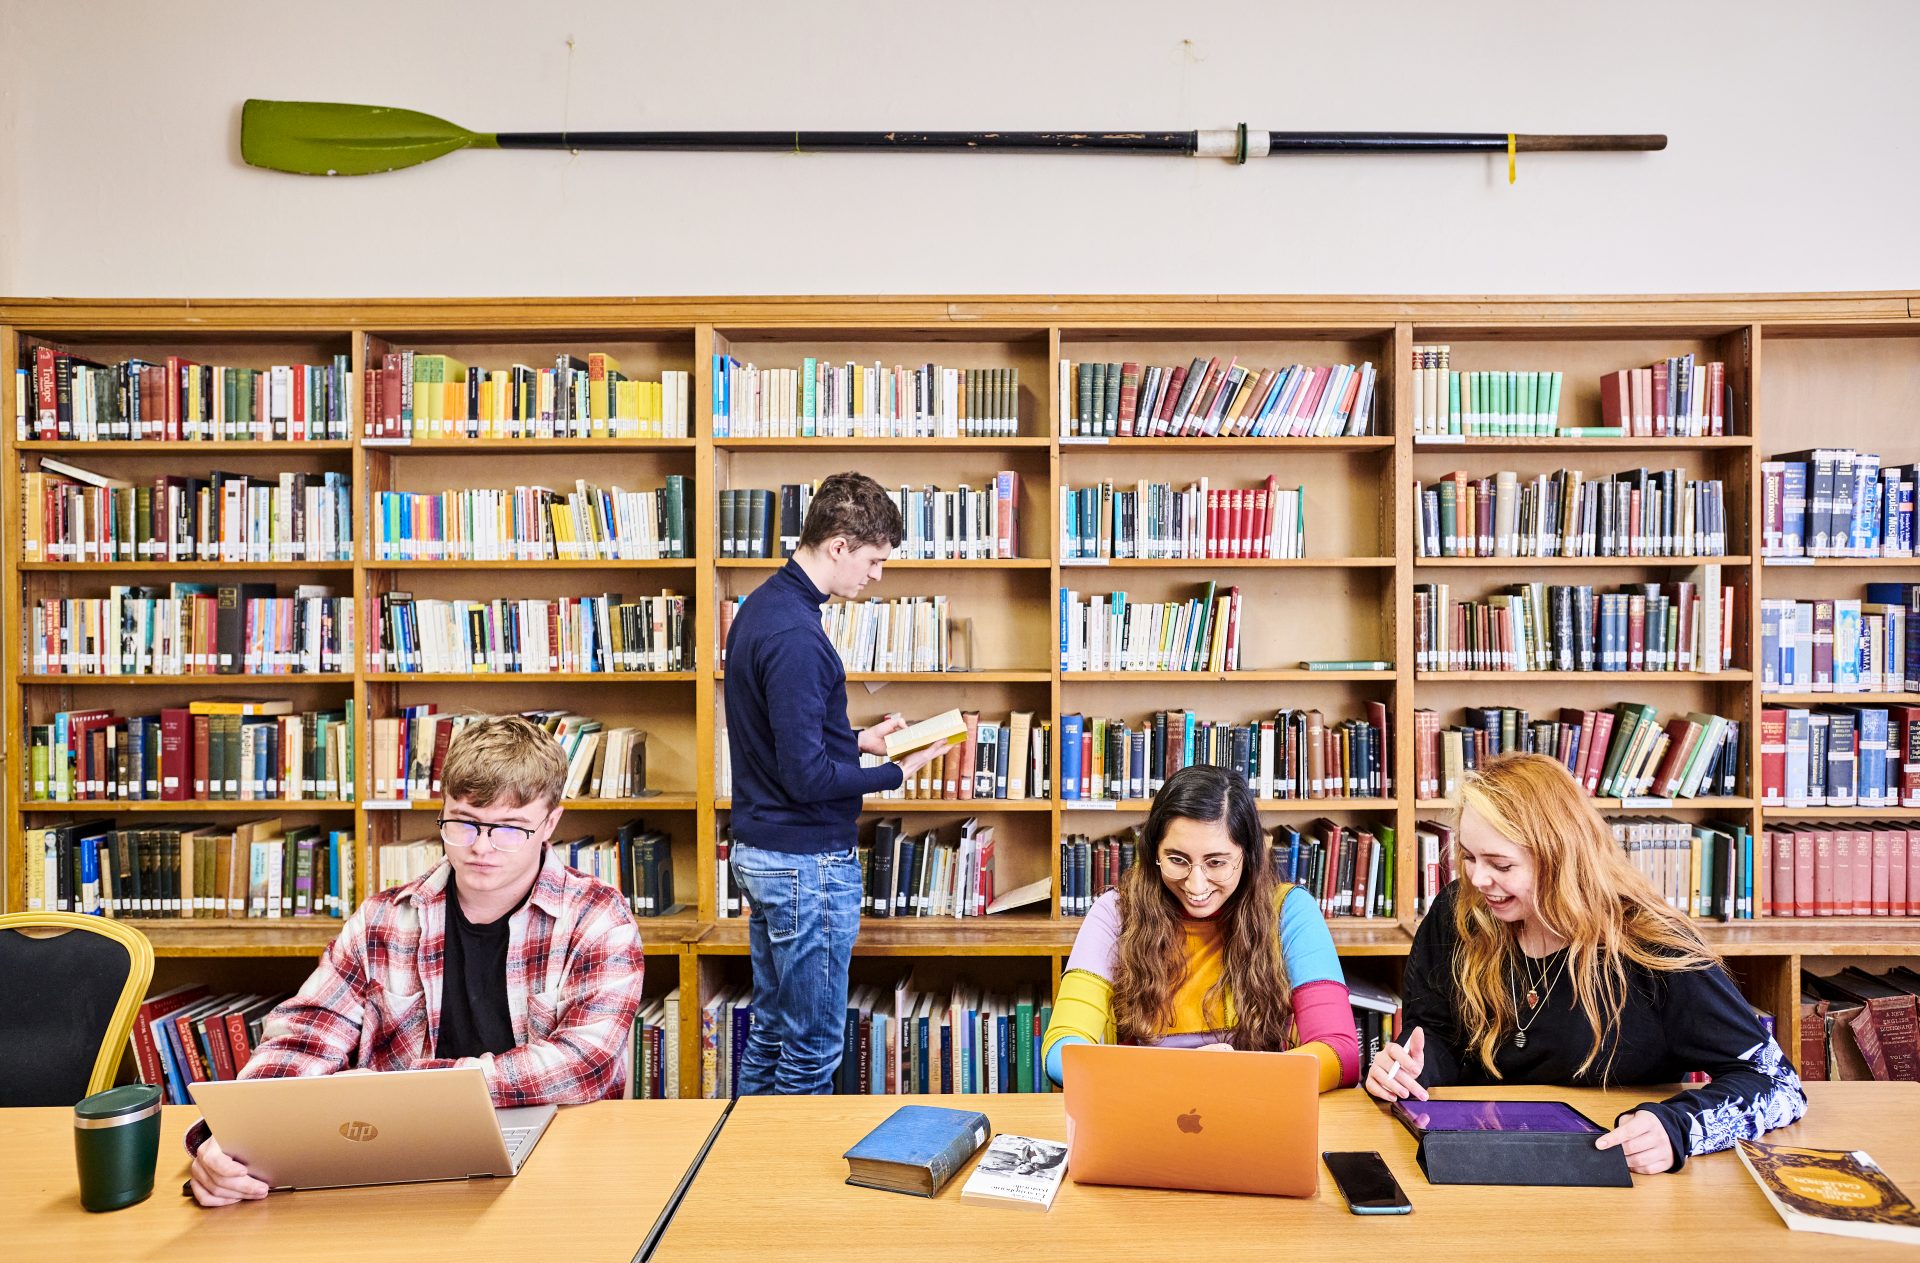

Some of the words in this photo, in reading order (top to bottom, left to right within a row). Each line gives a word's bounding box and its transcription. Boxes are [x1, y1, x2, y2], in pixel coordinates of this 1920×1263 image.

[42, 367, 53, 403] Trollope
[1767, 476, 1775, 524] QUOTATIONS
[1864, 475, 1877, 531] Dictionary
[1887, 482, 1898, 515] Popular
[1888, 516, 1897, 538] Musi
[668, 1010, 678, 1029] THE
[231, 1020, 245, 1052] 1900
[989, 1045, 997, 1074] COROT
[989, 1076, 997, 1086] IN
[346, 1121, 373, 1142] hp
